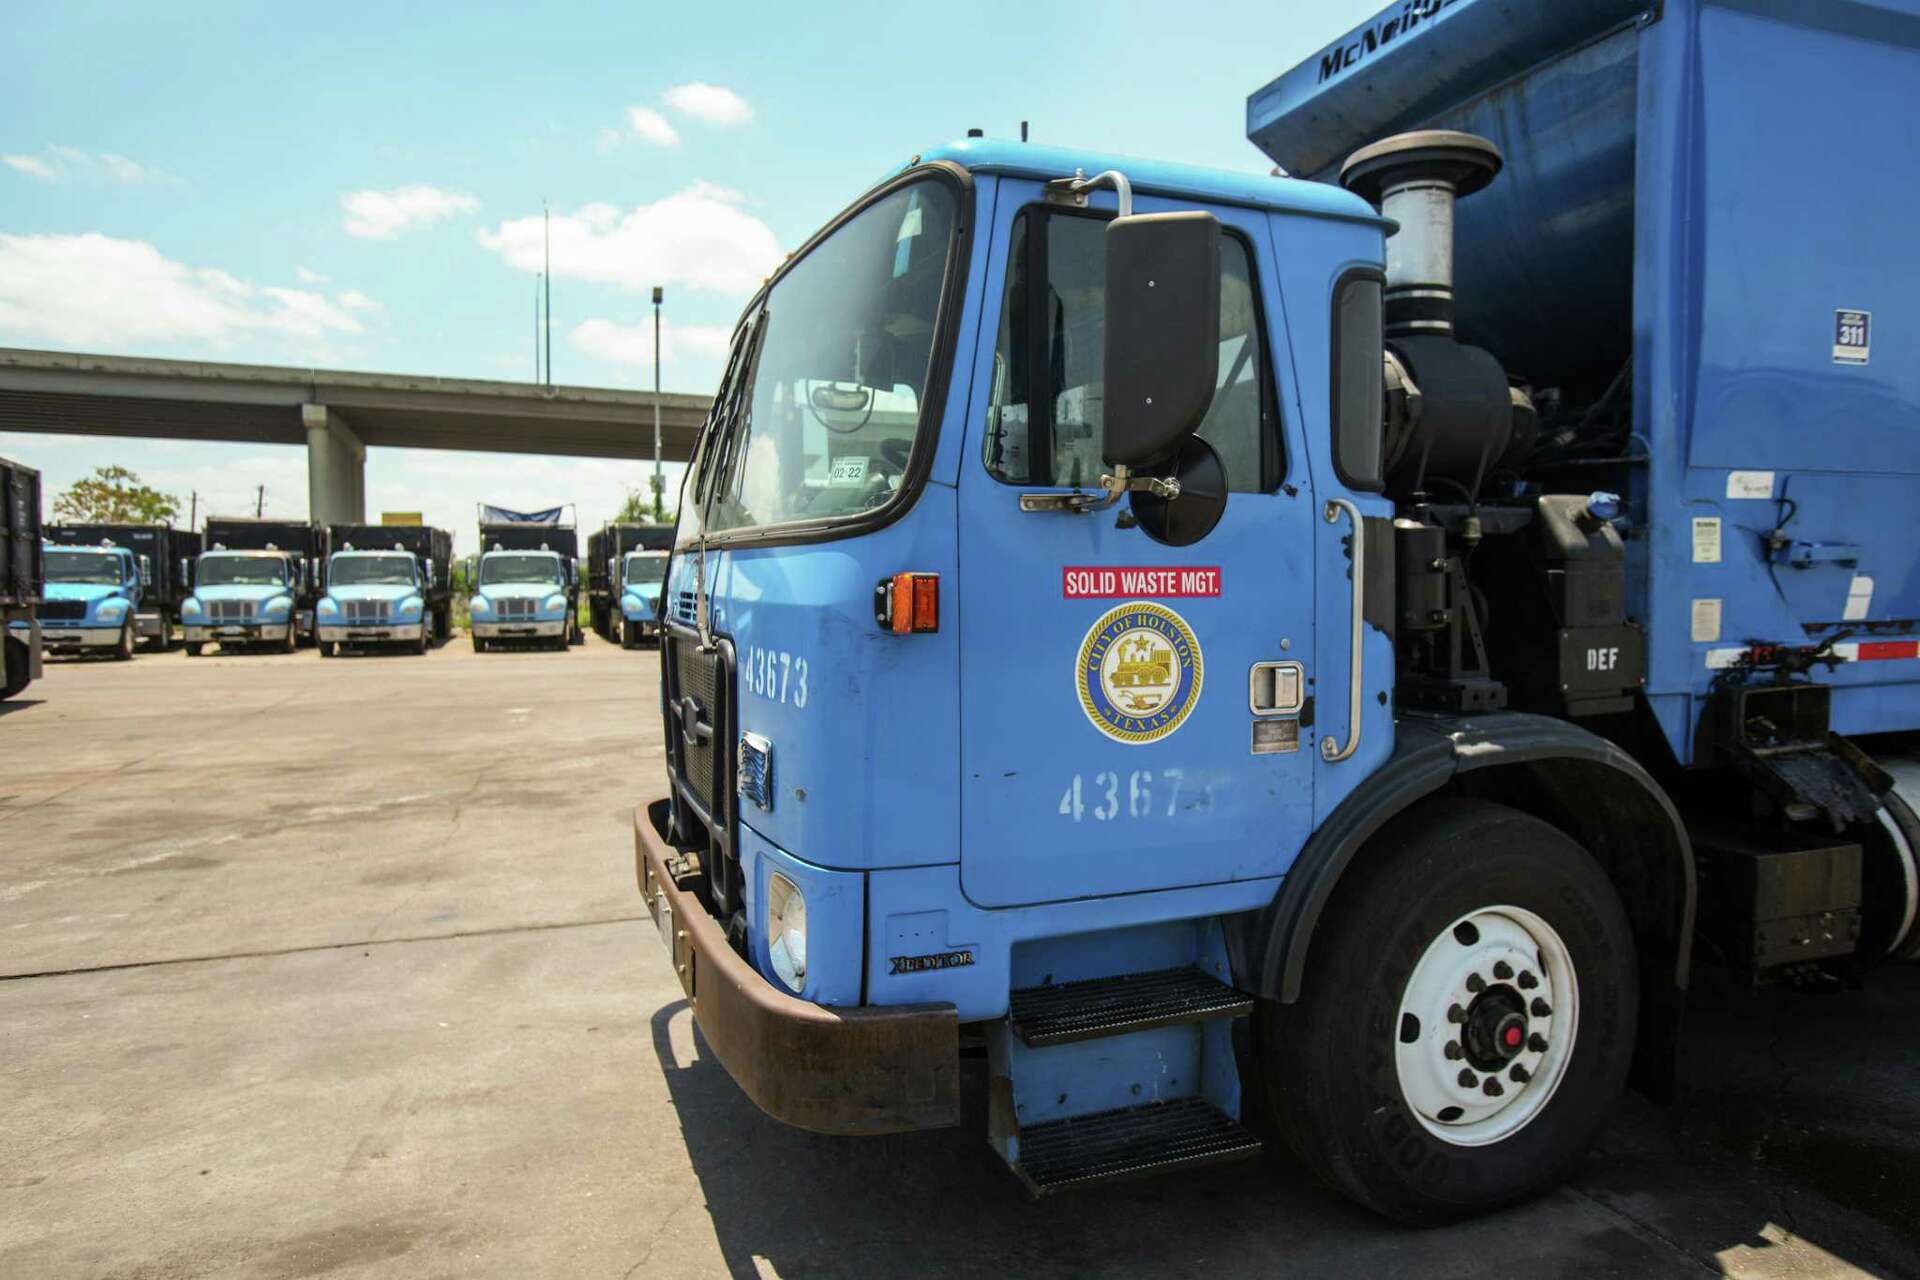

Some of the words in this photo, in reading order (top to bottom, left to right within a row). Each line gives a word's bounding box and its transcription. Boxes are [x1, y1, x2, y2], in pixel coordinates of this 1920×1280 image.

[1318, 0, 1458, 85] McNeilu
[1839, 326, 1864, 345] 311
[833, 467, 845, 479] 02
[847, 466, 861, 478] 22
[1066, 571, 1116, 595] SOLID
[1121, 571, 1177, 594] WASTE
[1181, 571, 1219, 594] MGT.
[1088, 630, 1114, 672] CITY
[1112, 616, 1133, 635] OF
[1137, 614, 1193, 669] HOUSTON
[1586, 647, 1619, 671] DEF
[745, 644, 808, 709] 43673
[1111, 711, 1170, 731] TEXAS
